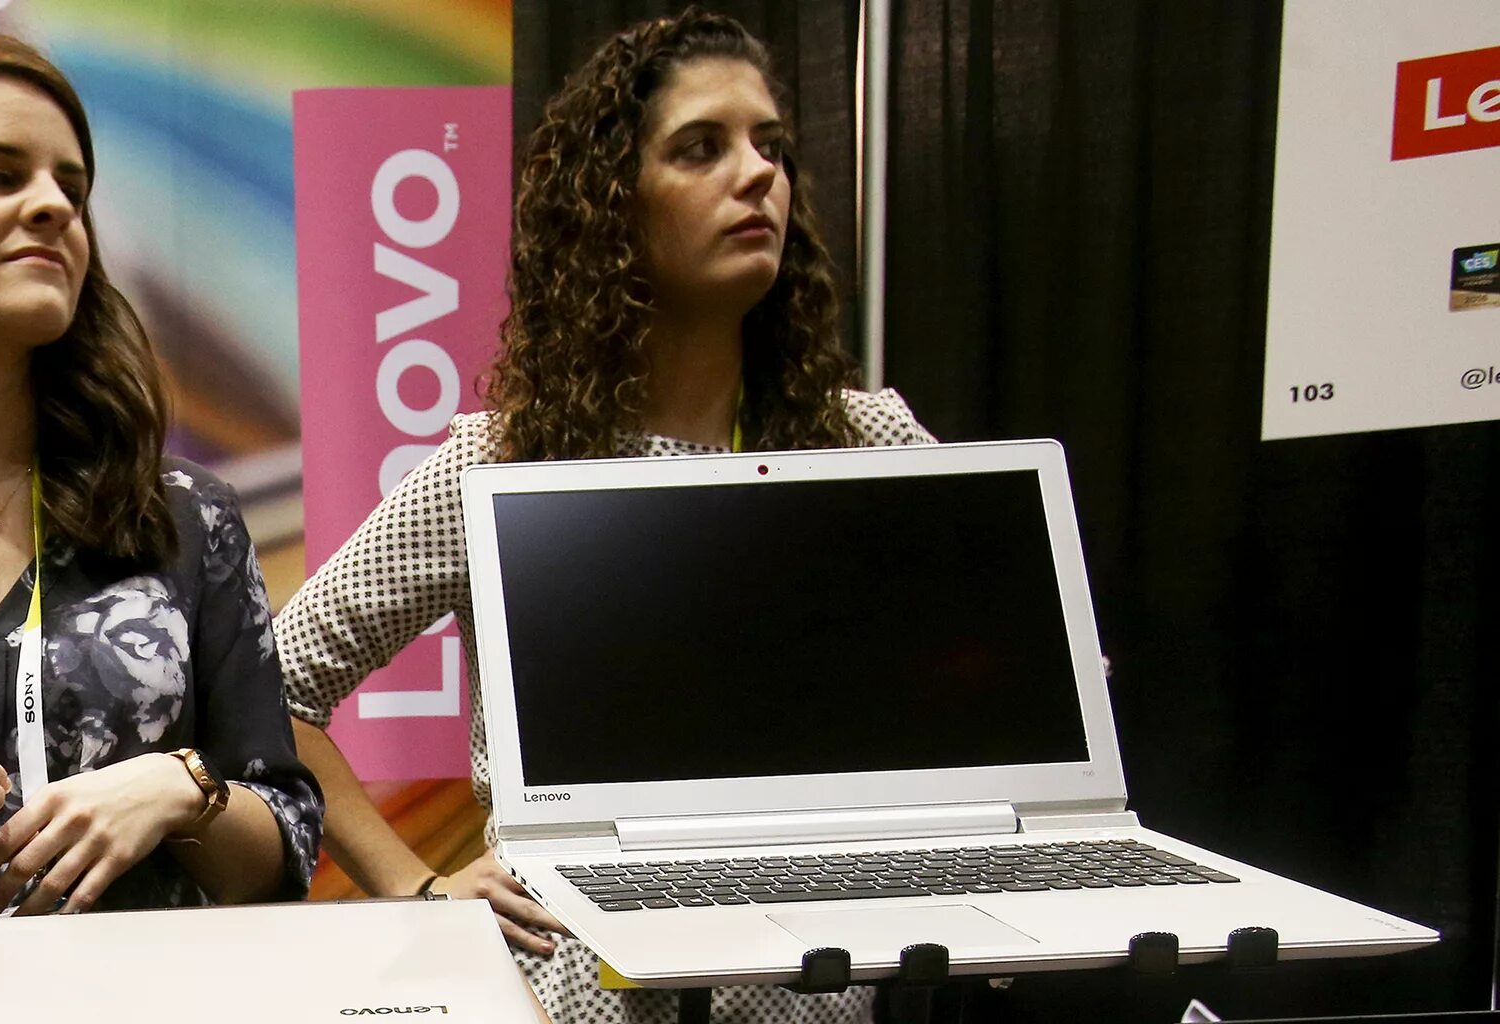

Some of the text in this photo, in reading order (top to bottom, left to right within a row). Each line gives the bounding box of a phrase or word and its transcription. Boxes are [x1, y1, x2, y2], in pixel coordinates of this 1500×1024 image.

[1289, 383, 1334, 402] 103
[24, 672, 36, 724] SONY
[524, 792, 571, 803] Lenovo
[340, 1005, 448, 1016] Lenovo
